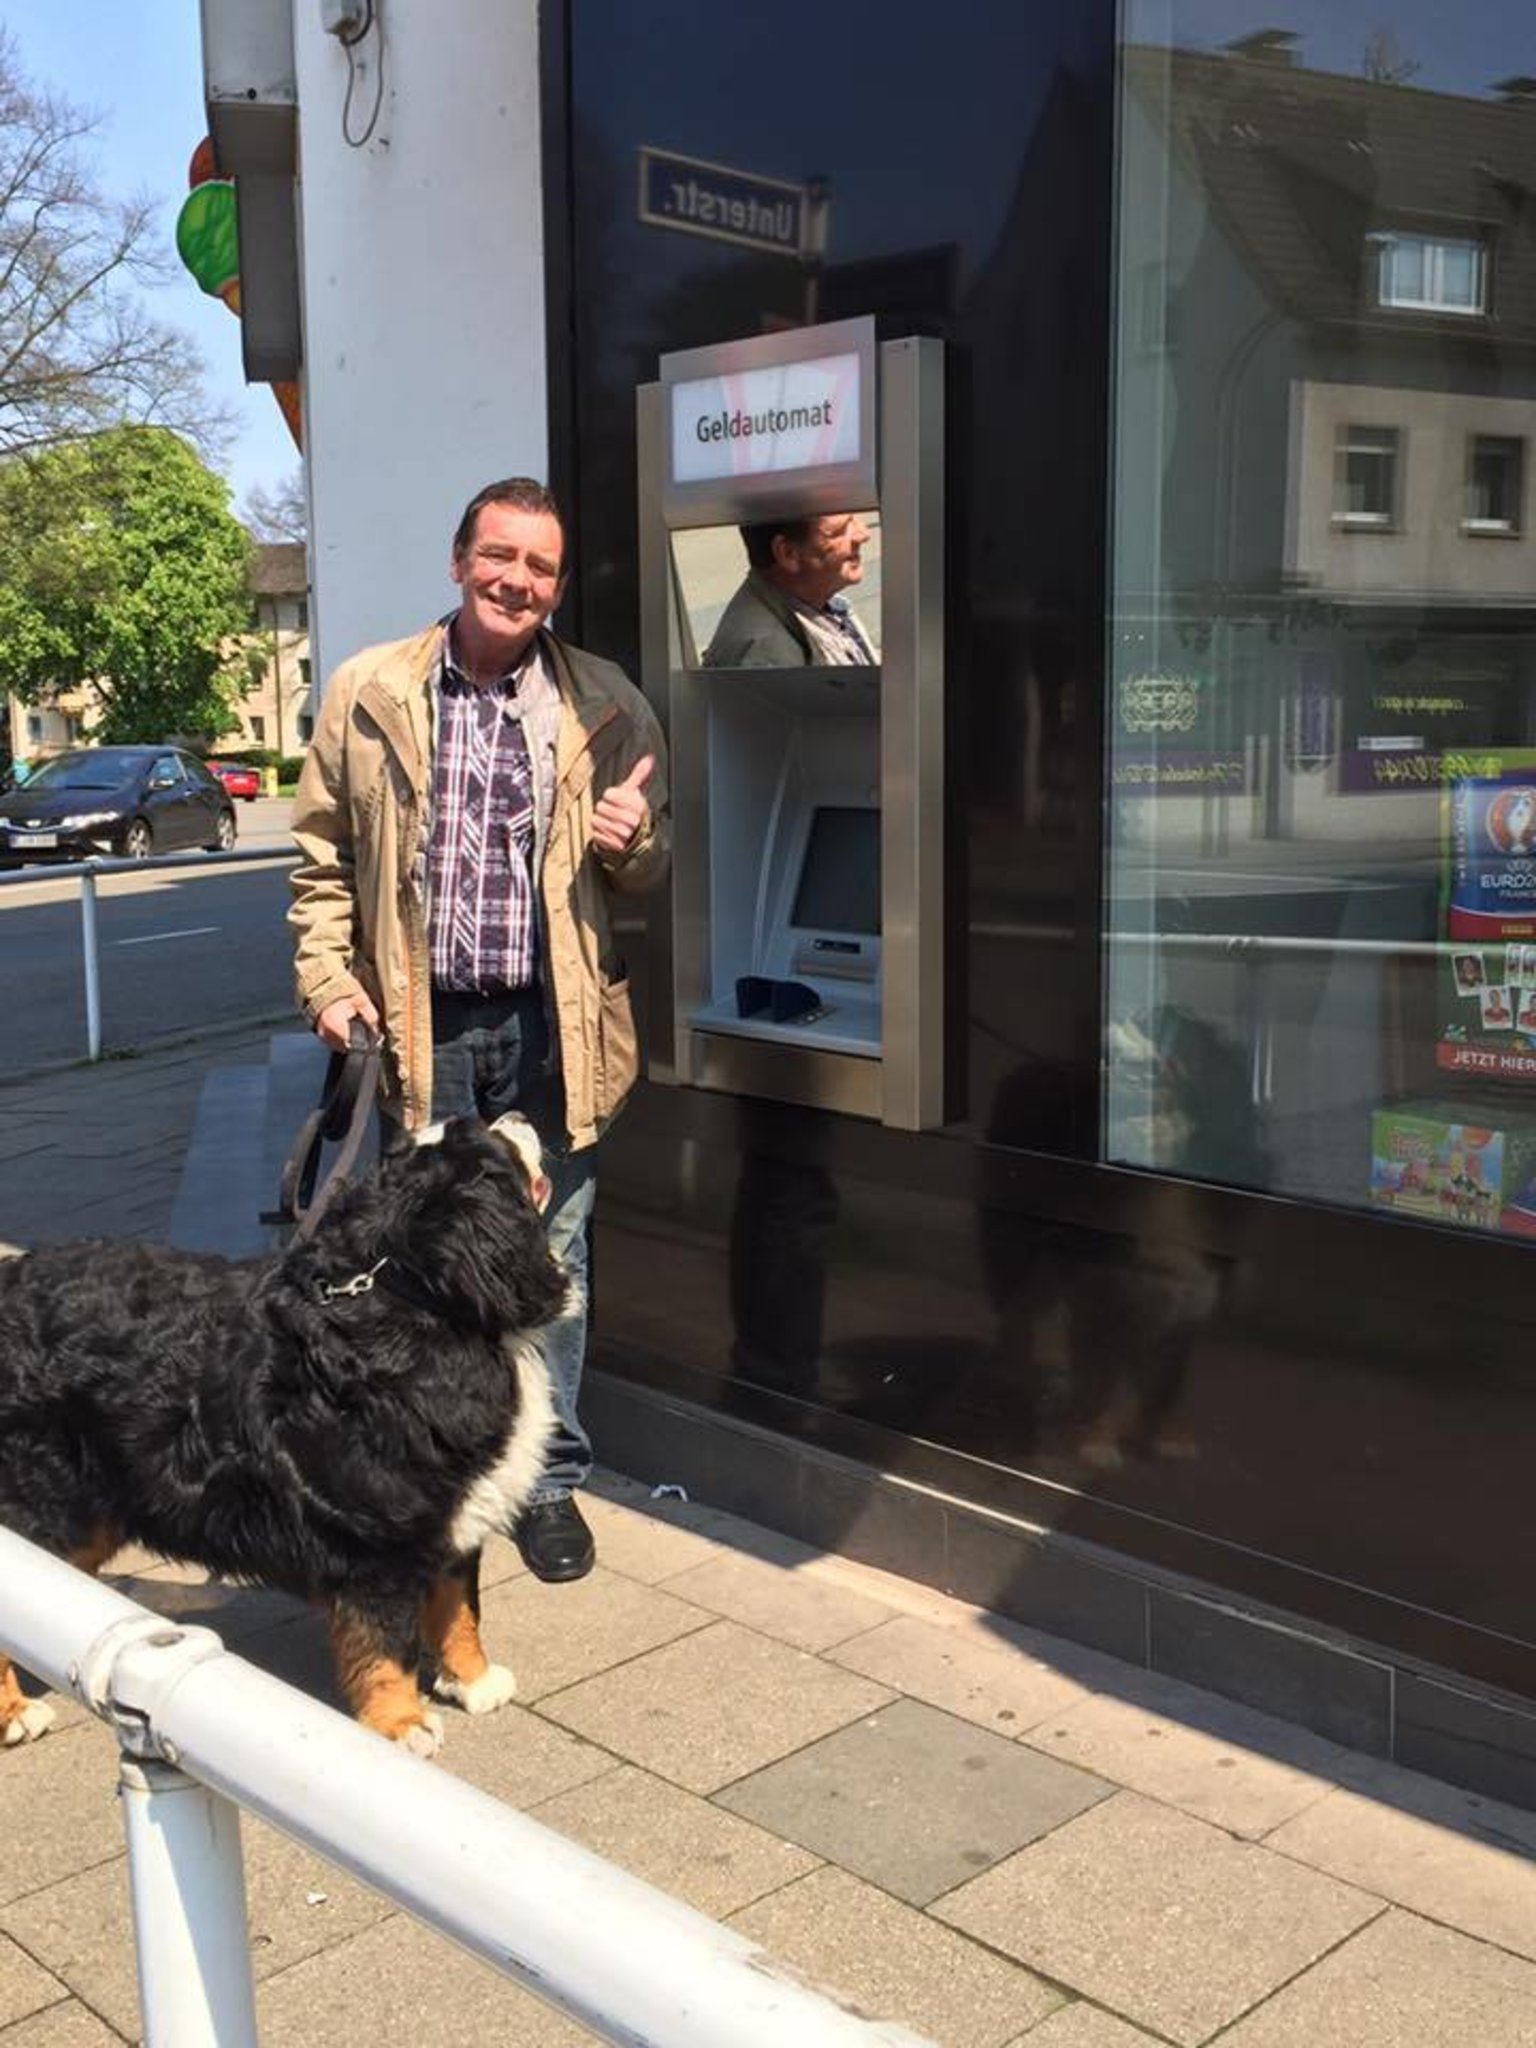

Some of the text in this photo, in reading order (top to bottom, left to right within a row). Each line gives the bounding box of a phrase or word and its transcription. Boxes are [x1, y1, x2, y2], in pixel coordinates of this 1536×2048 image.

[695, 399, 833, 442] Geldautomat
[1481, 874, 1536, 888] EURO2
[1453, 1048, 1497, 1068] JETZT
